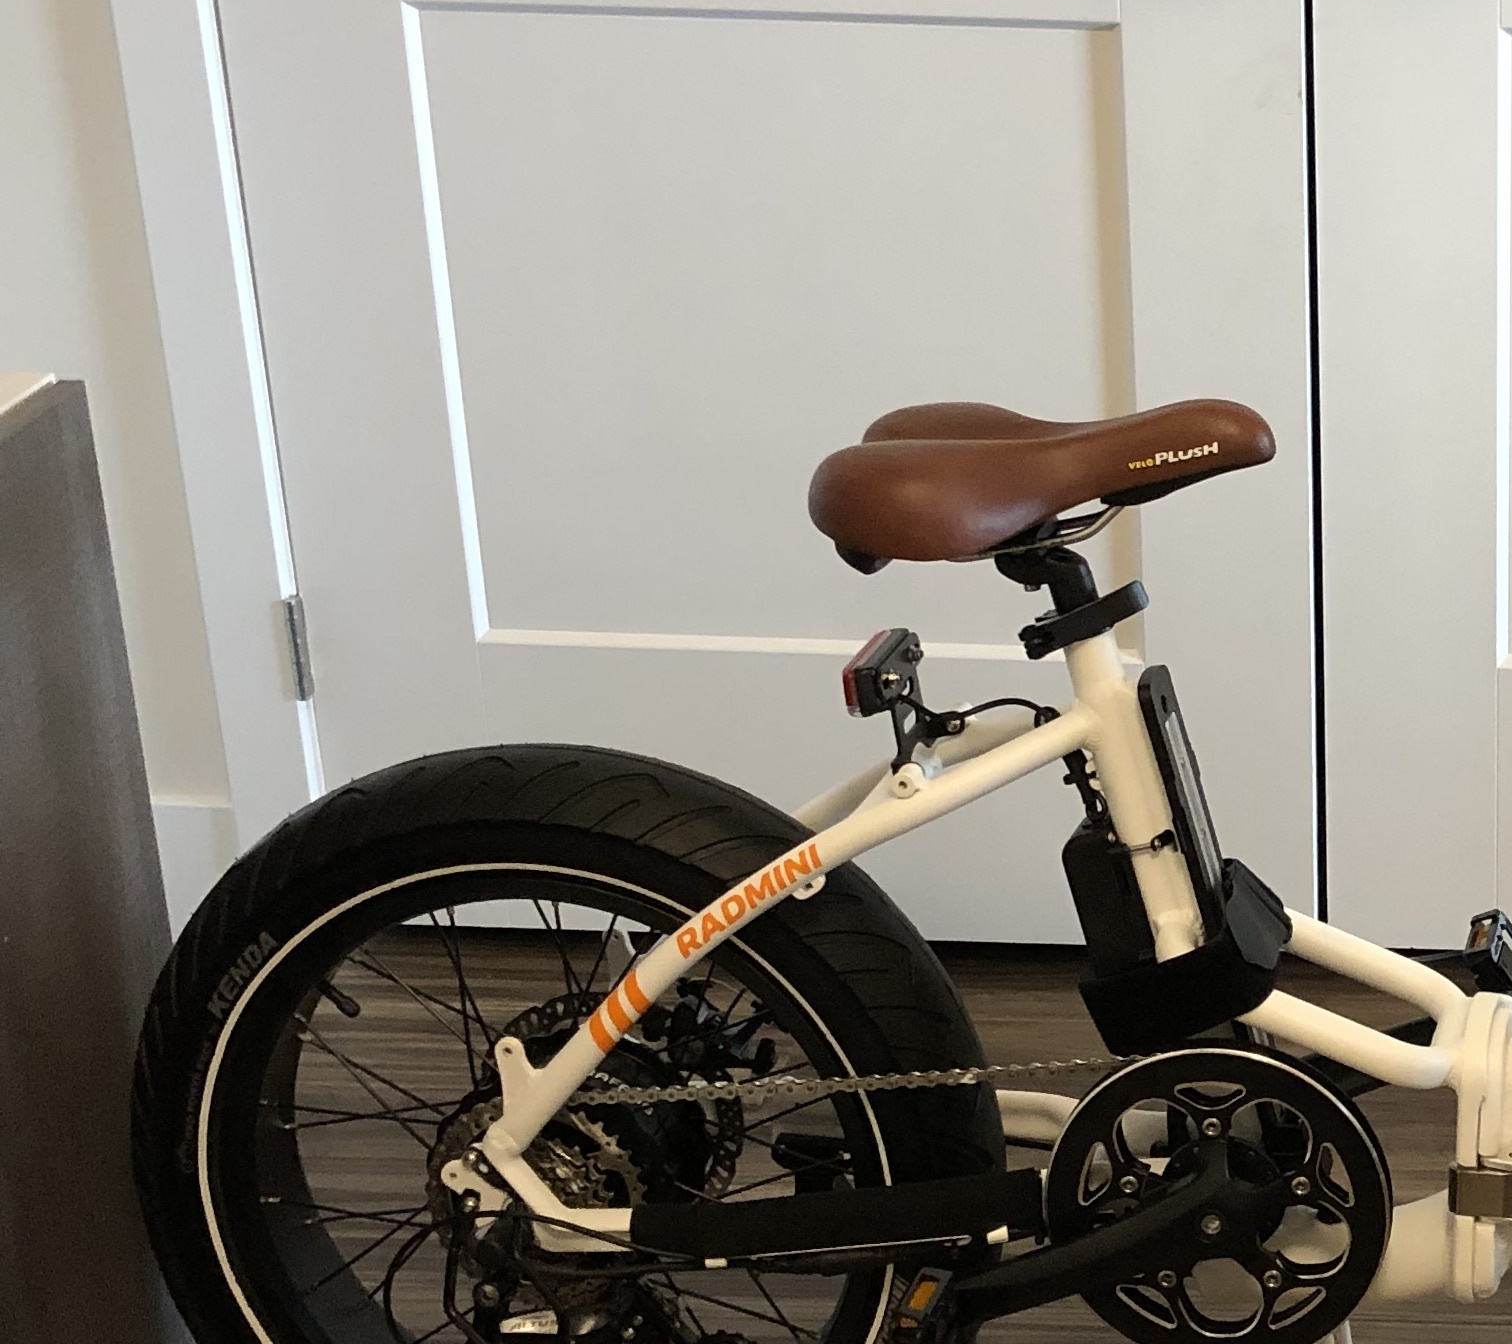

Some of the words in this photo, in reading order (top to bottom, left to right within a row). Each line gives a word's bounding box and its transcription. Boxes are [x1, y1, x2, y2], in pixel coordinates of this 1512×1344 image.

[1155, 441, 1219, 466] PLUSH
[676, 843, 823, 959] RADMINI
[207, 931, 279, 1020] KENDA
